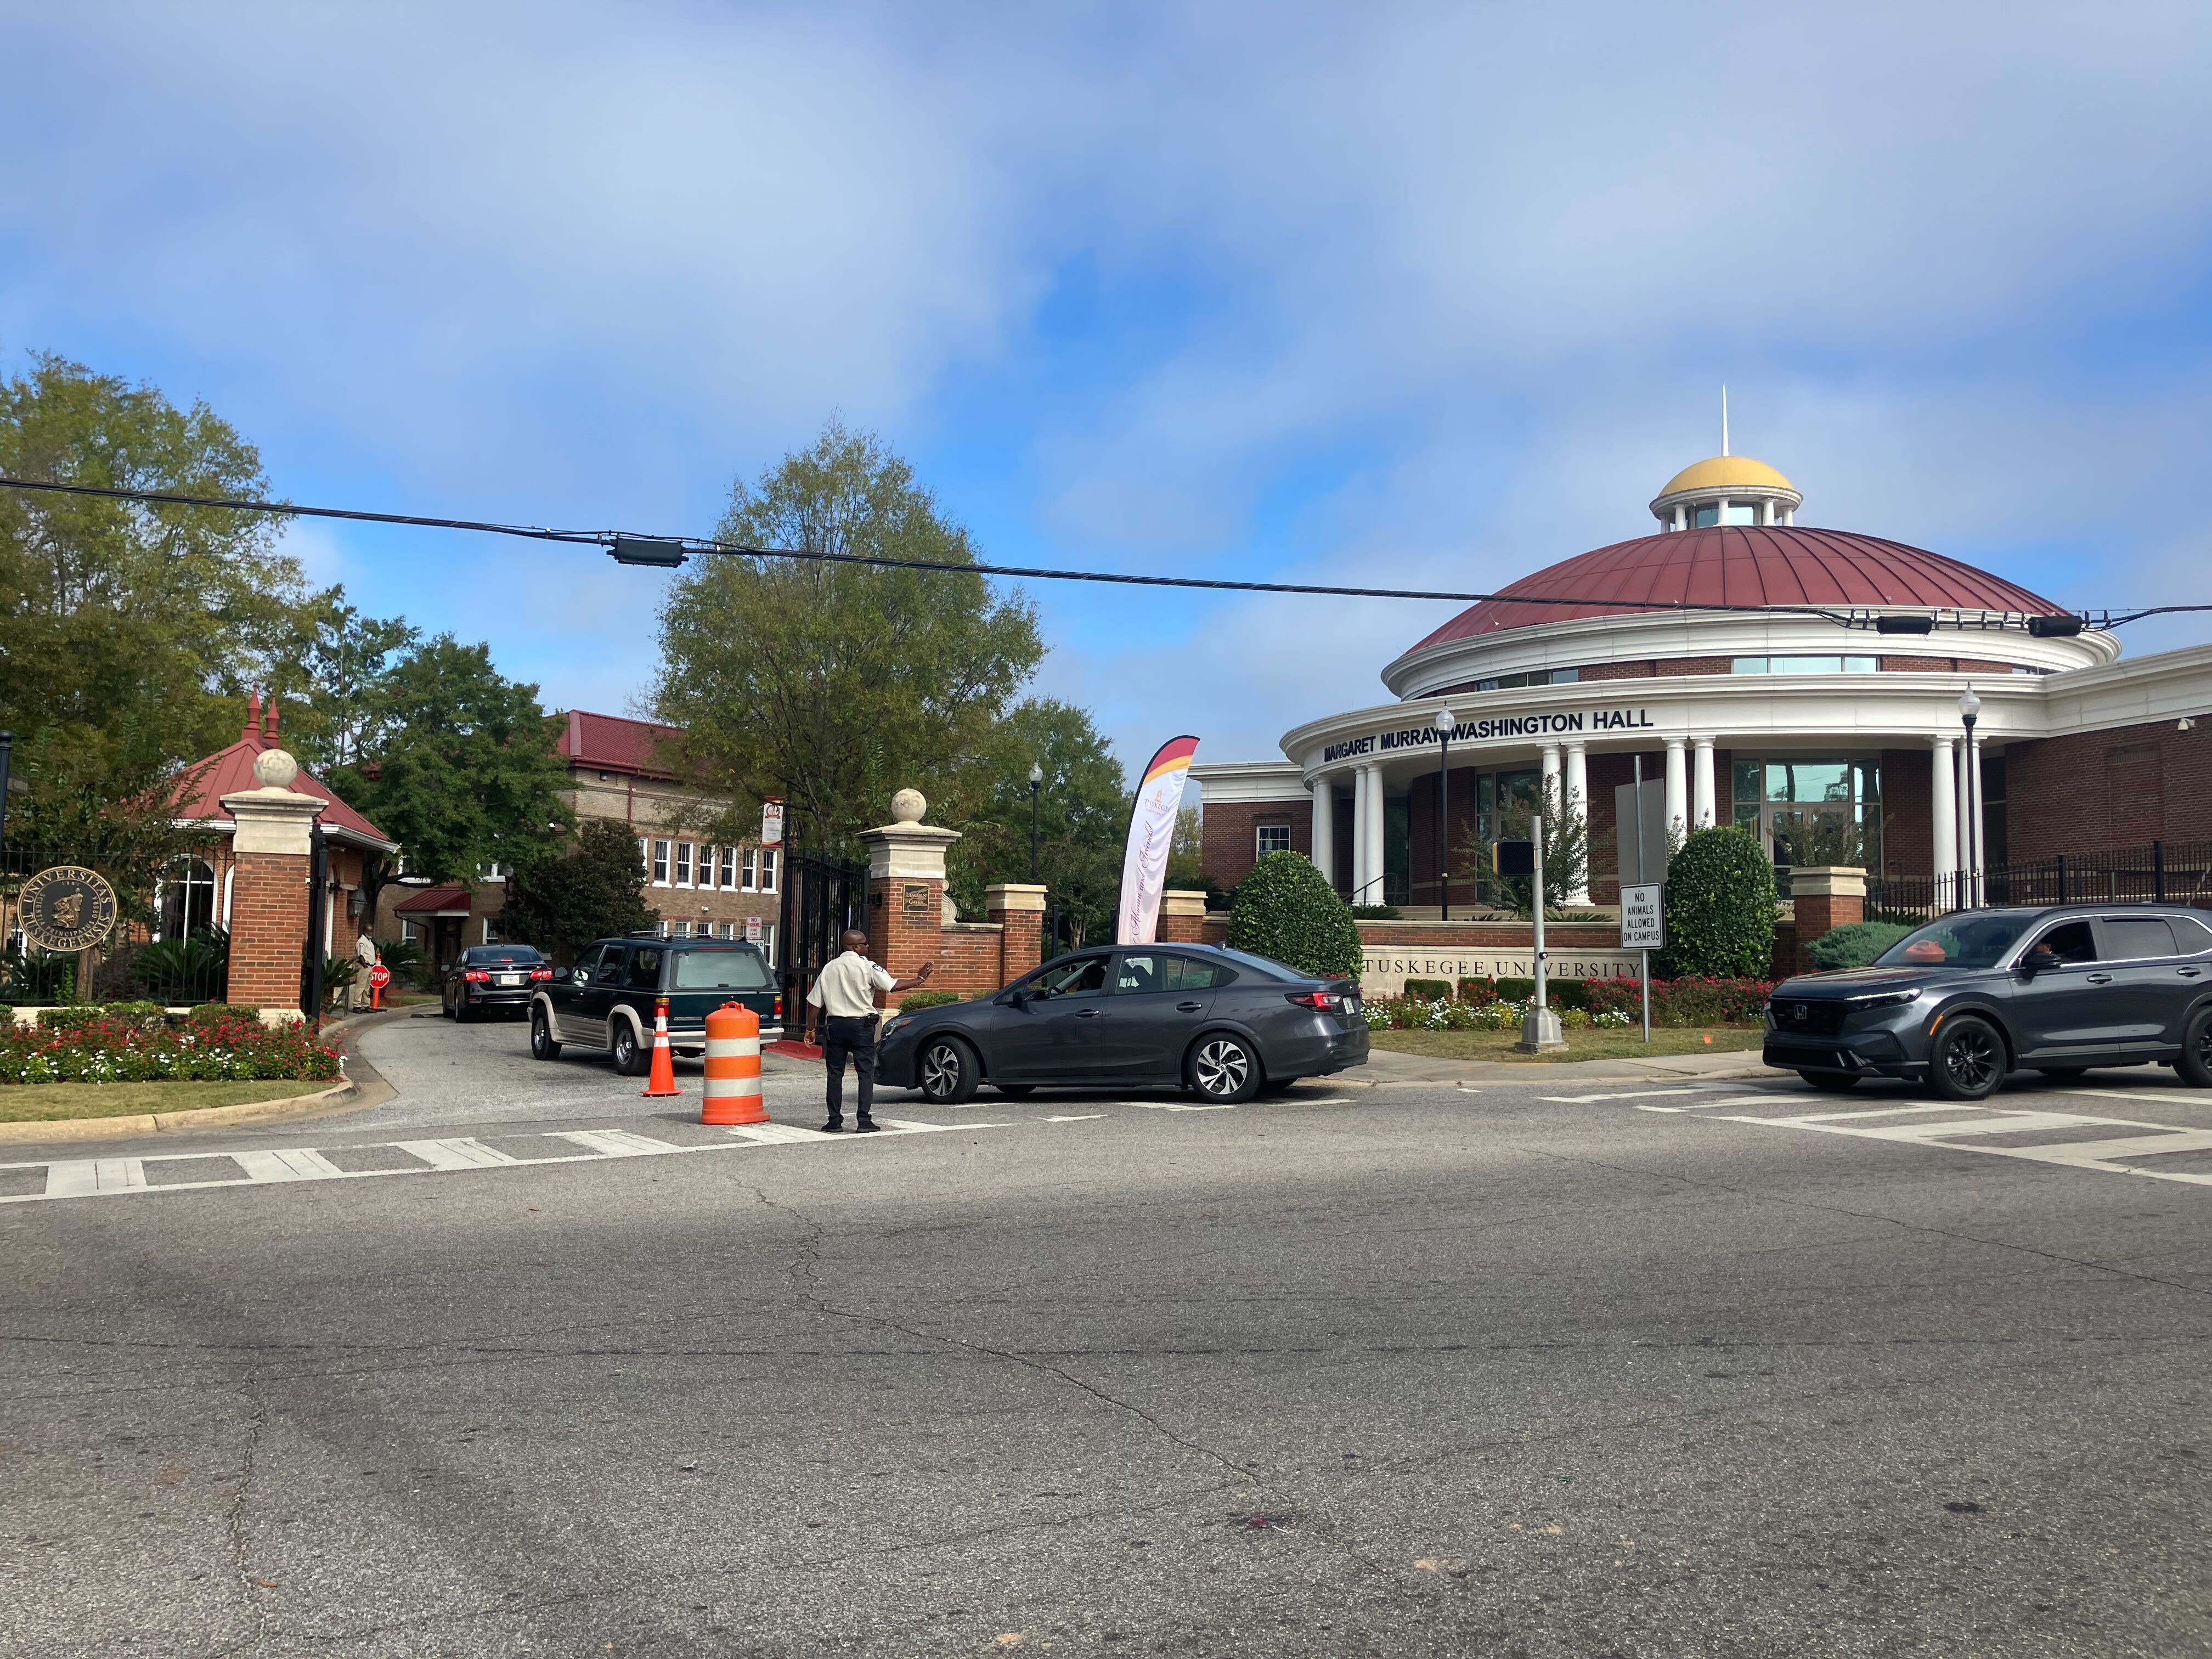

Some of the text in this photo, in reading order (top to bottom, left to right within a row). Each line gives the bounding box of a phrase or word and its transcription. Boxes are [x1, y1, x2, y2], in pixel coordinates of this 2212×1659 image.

[1324, 709, 1654, 763] MARGARET MURRAY WASHINGTON HALL
[1144, 799, 1170, 812] TUSKEGEE
[24, 870, 111, 904] UNIVERSITAS
[1130, 891, 1142, 936] Alumni
[1137, 865, 1146, 892] and
[1635, 892, 1645, 902] NO
[35, 893, 46, 926] SCIENTIA
[1627, 905, 1654, 916] ANIMALS
[22, 912, 110, 948] TUSKEGEENSIS
[46, 921, 94, 936] PRINCIPATUS
[1627, 918, 1655, 928] ALLOWED
[1624, 930, 1659, 941] ON CAMPUS
[1363, 960, 1640, 978] TUSKEGEE UNIVERSITY
